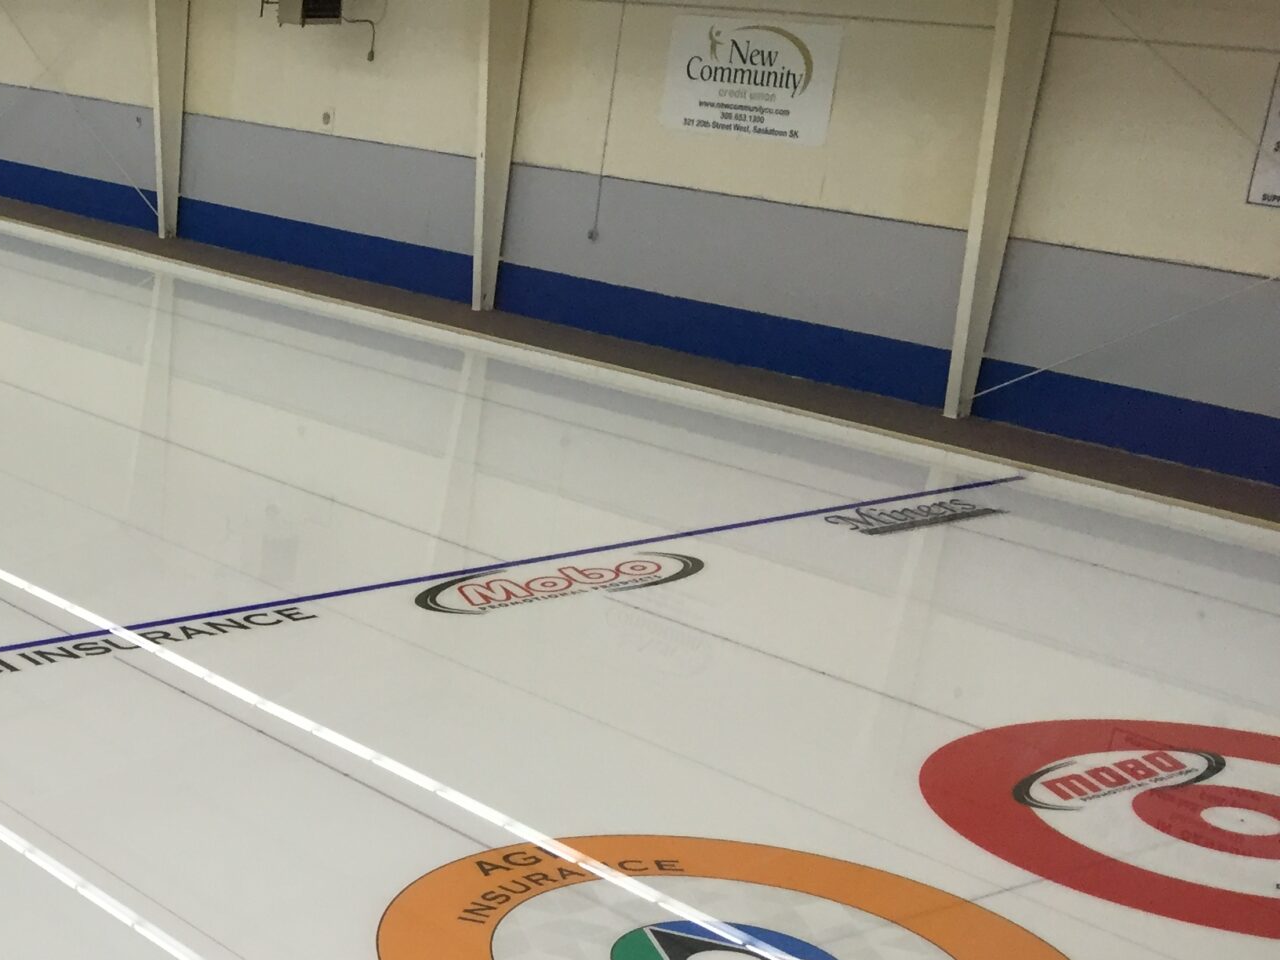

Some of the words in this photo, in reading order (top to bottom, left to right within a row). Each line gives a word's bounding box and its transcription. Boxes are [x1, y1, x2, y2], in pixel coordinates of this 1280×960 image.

[729, 39, 779, 67] New
[686, 55, 804, 98] Community
[718, 88, 748, 100] credit
[457, 560, 642, 607] Mobo
[478, 588, 588, 611] PROMOTIONAL
[591, 575, 663, 591] PRODUCTS
[18, 606, 318, 666] INSURANCE
[1040, 751, 1188, 801] MOBO
[457, 859, 685, 925] INSURACE
